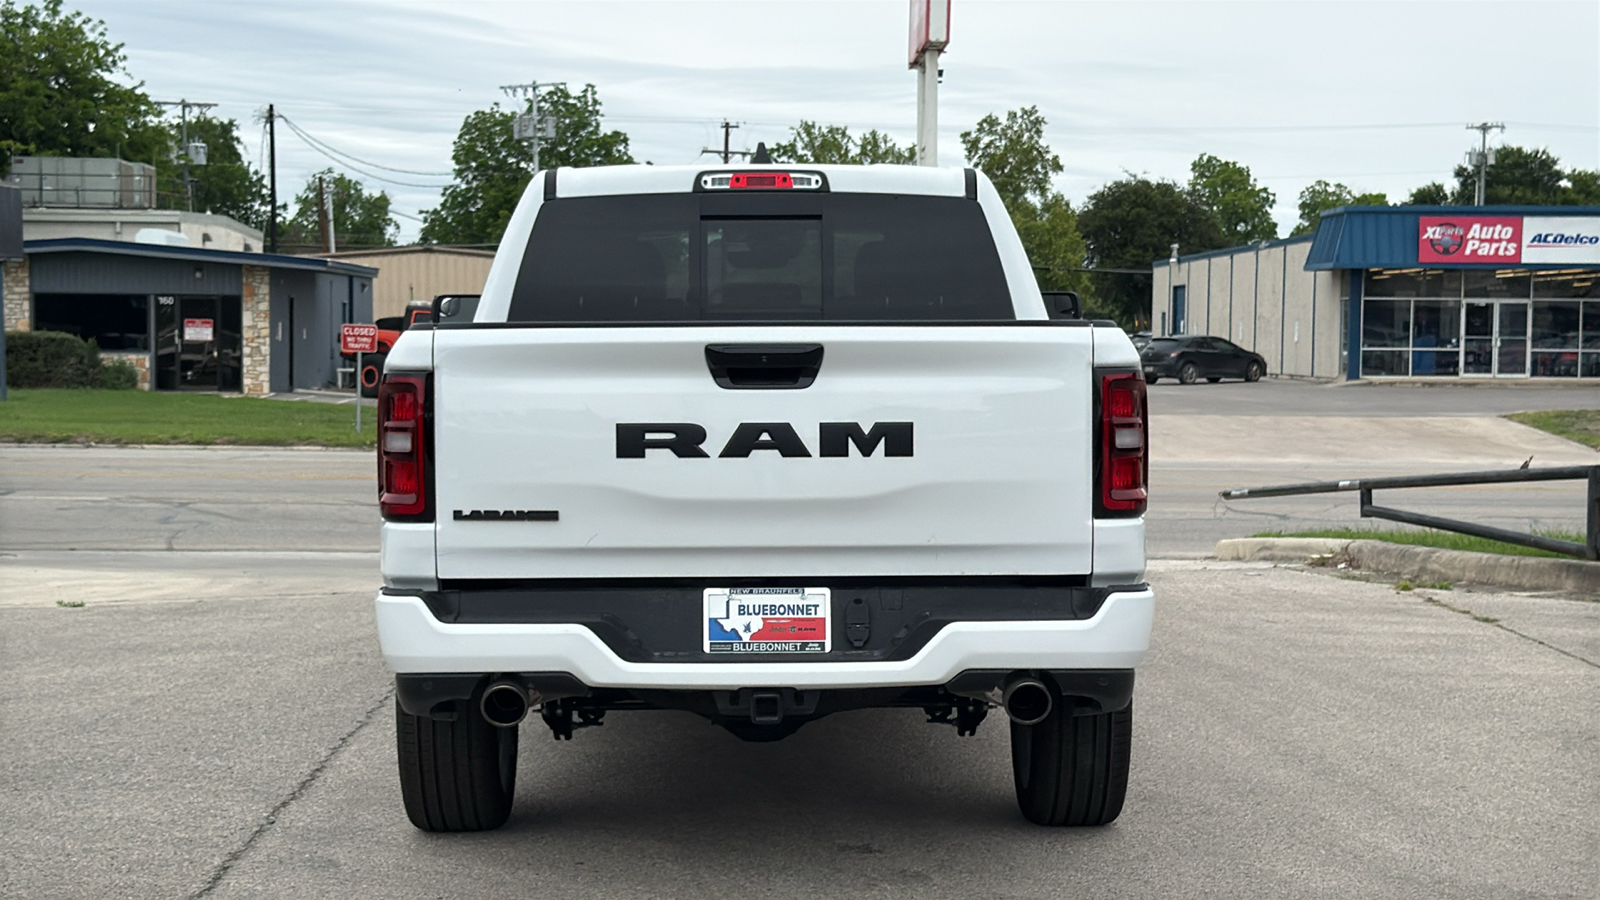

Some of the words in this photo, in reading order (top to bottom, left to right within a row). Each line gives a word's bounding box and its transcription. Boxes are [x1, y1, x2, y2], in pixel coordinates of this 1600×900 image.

[1467, 223, 1513, 239] Auto
[1530, 233, 1599, 245] ACDelco
[1464, 240, 1517, 256] Parts
[344, 327, 375, 336] CLOSED
[616, 421, 914, 459] RAM
[738, 604, 819, 616] BLUEBONNET
[732, 643, 802, 651] BLUEBONNET
